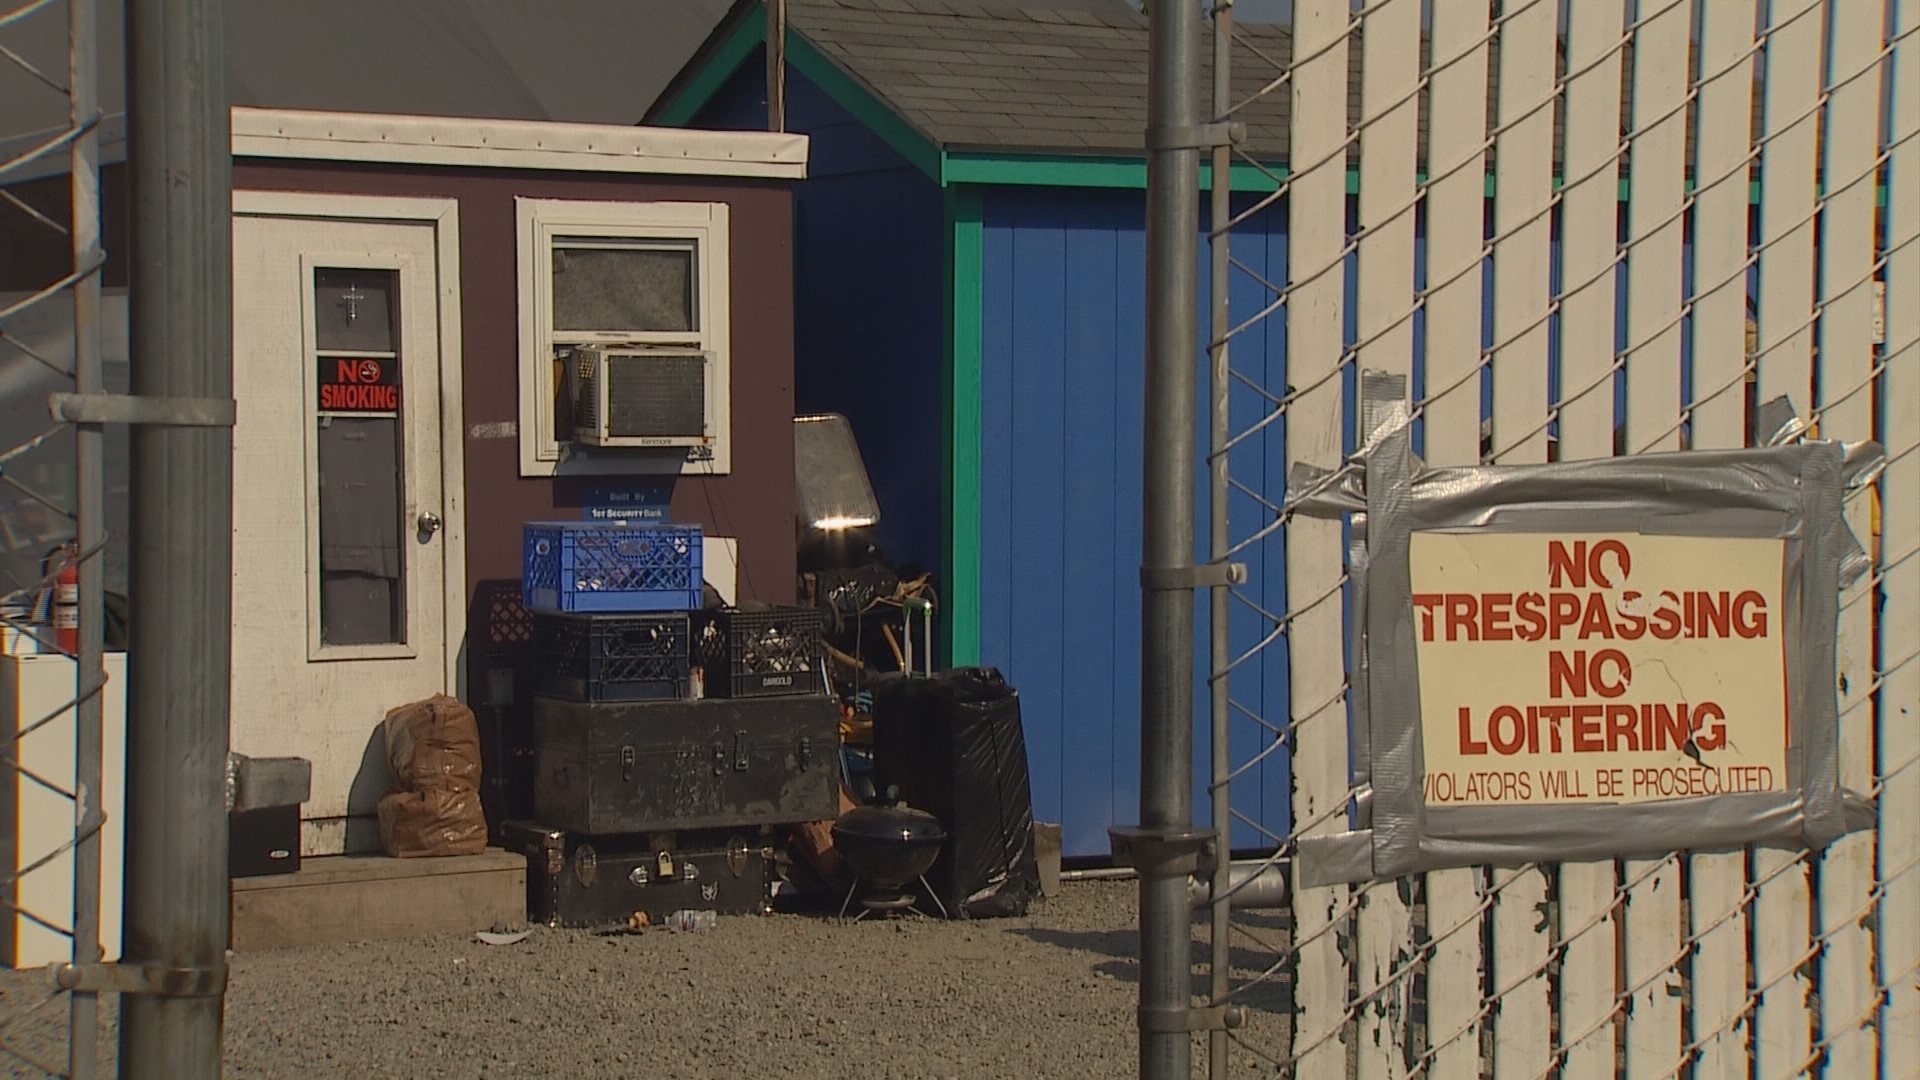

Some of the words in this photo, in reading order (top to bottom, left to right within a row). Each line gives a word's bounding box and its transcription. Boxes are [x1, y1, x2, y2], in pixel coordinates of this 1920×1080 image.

[338, 360, 380, 383] NO
[321, 384, 396, 408] SMOKING
[643, 508, 662, 518] Bank
[1548, 539, 1632, 589] NO
[1413, 591, 1768, 642] TRESPASSING
[1549, 648, 1632, 699] NO
[1458, 702, 1726, 755] LOITERING
[1539, 769, 1588, 799] WILL
[1596, 768, 1625, 797] BE
[1633, 766, 1773, 796] PROSECUTED
